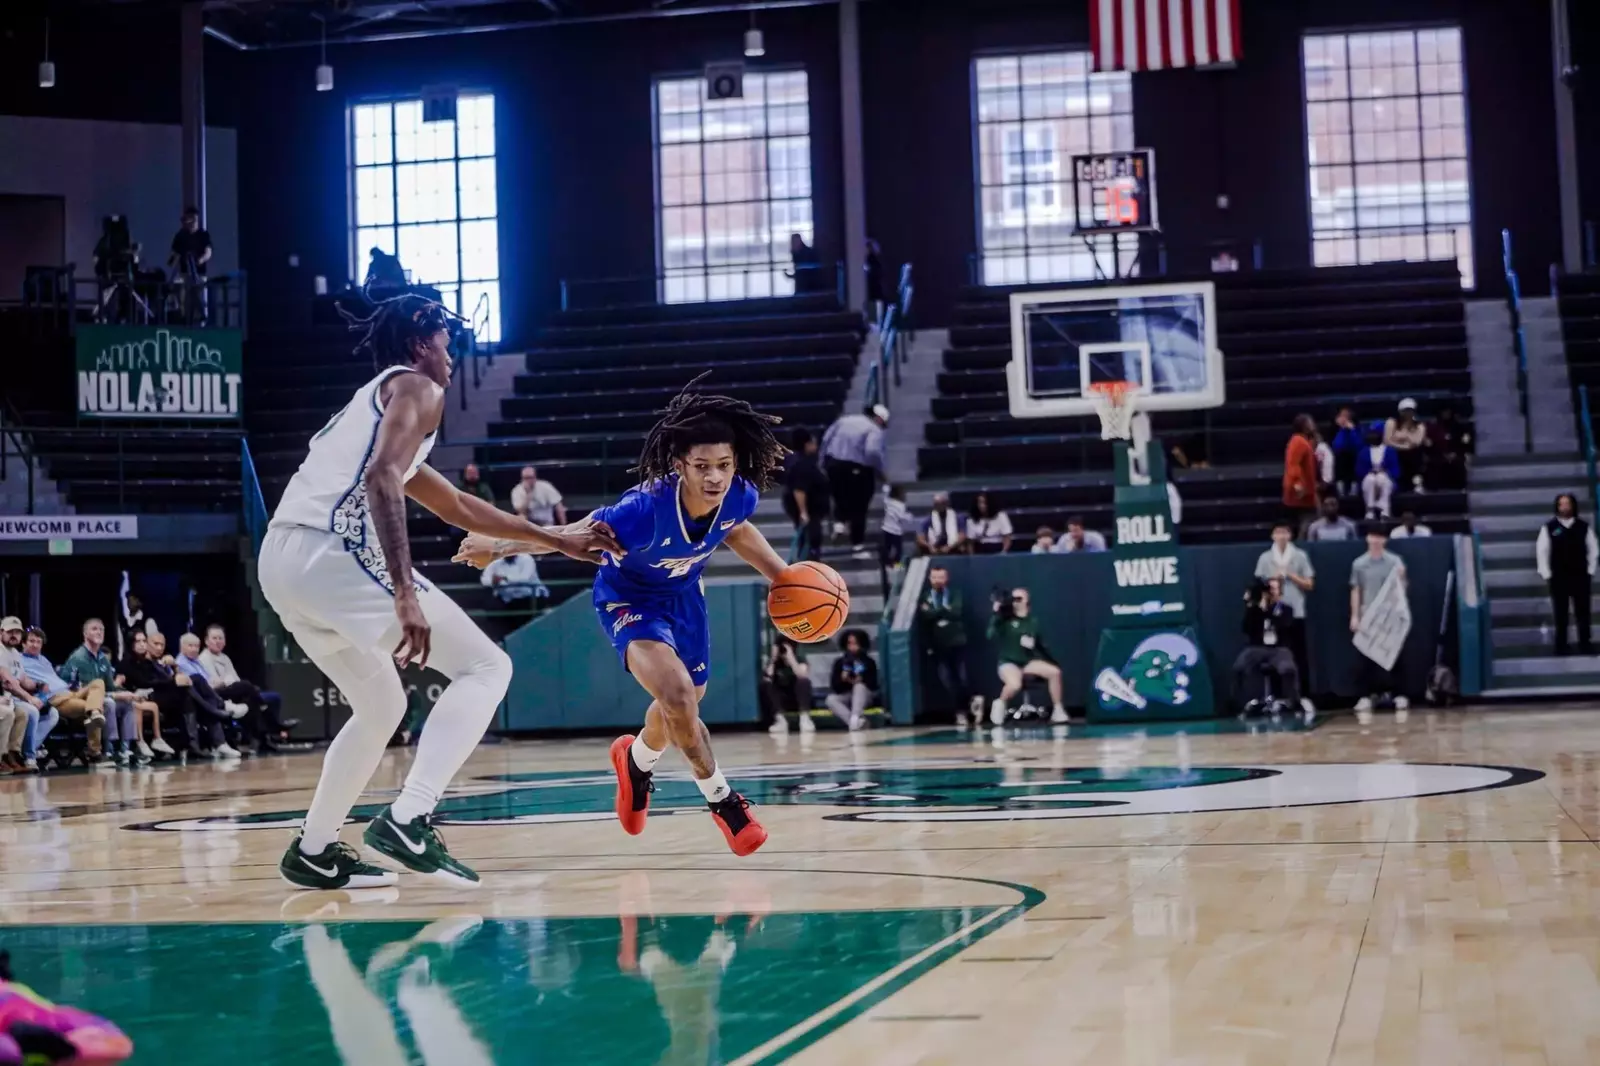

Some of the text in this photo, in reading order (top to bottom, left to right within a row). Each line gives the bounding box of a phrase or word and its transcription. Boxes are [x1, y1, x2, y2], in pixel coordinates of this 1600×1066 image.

[78, 371, 242, 414] NOLA BUILT
[77, 521, 121, 533] PLACE
[1116, 514, 1171, 544] ROLL
[1114, 556, 1179, 587] WAVE
[612, 613, 643, 638] Tulsa
